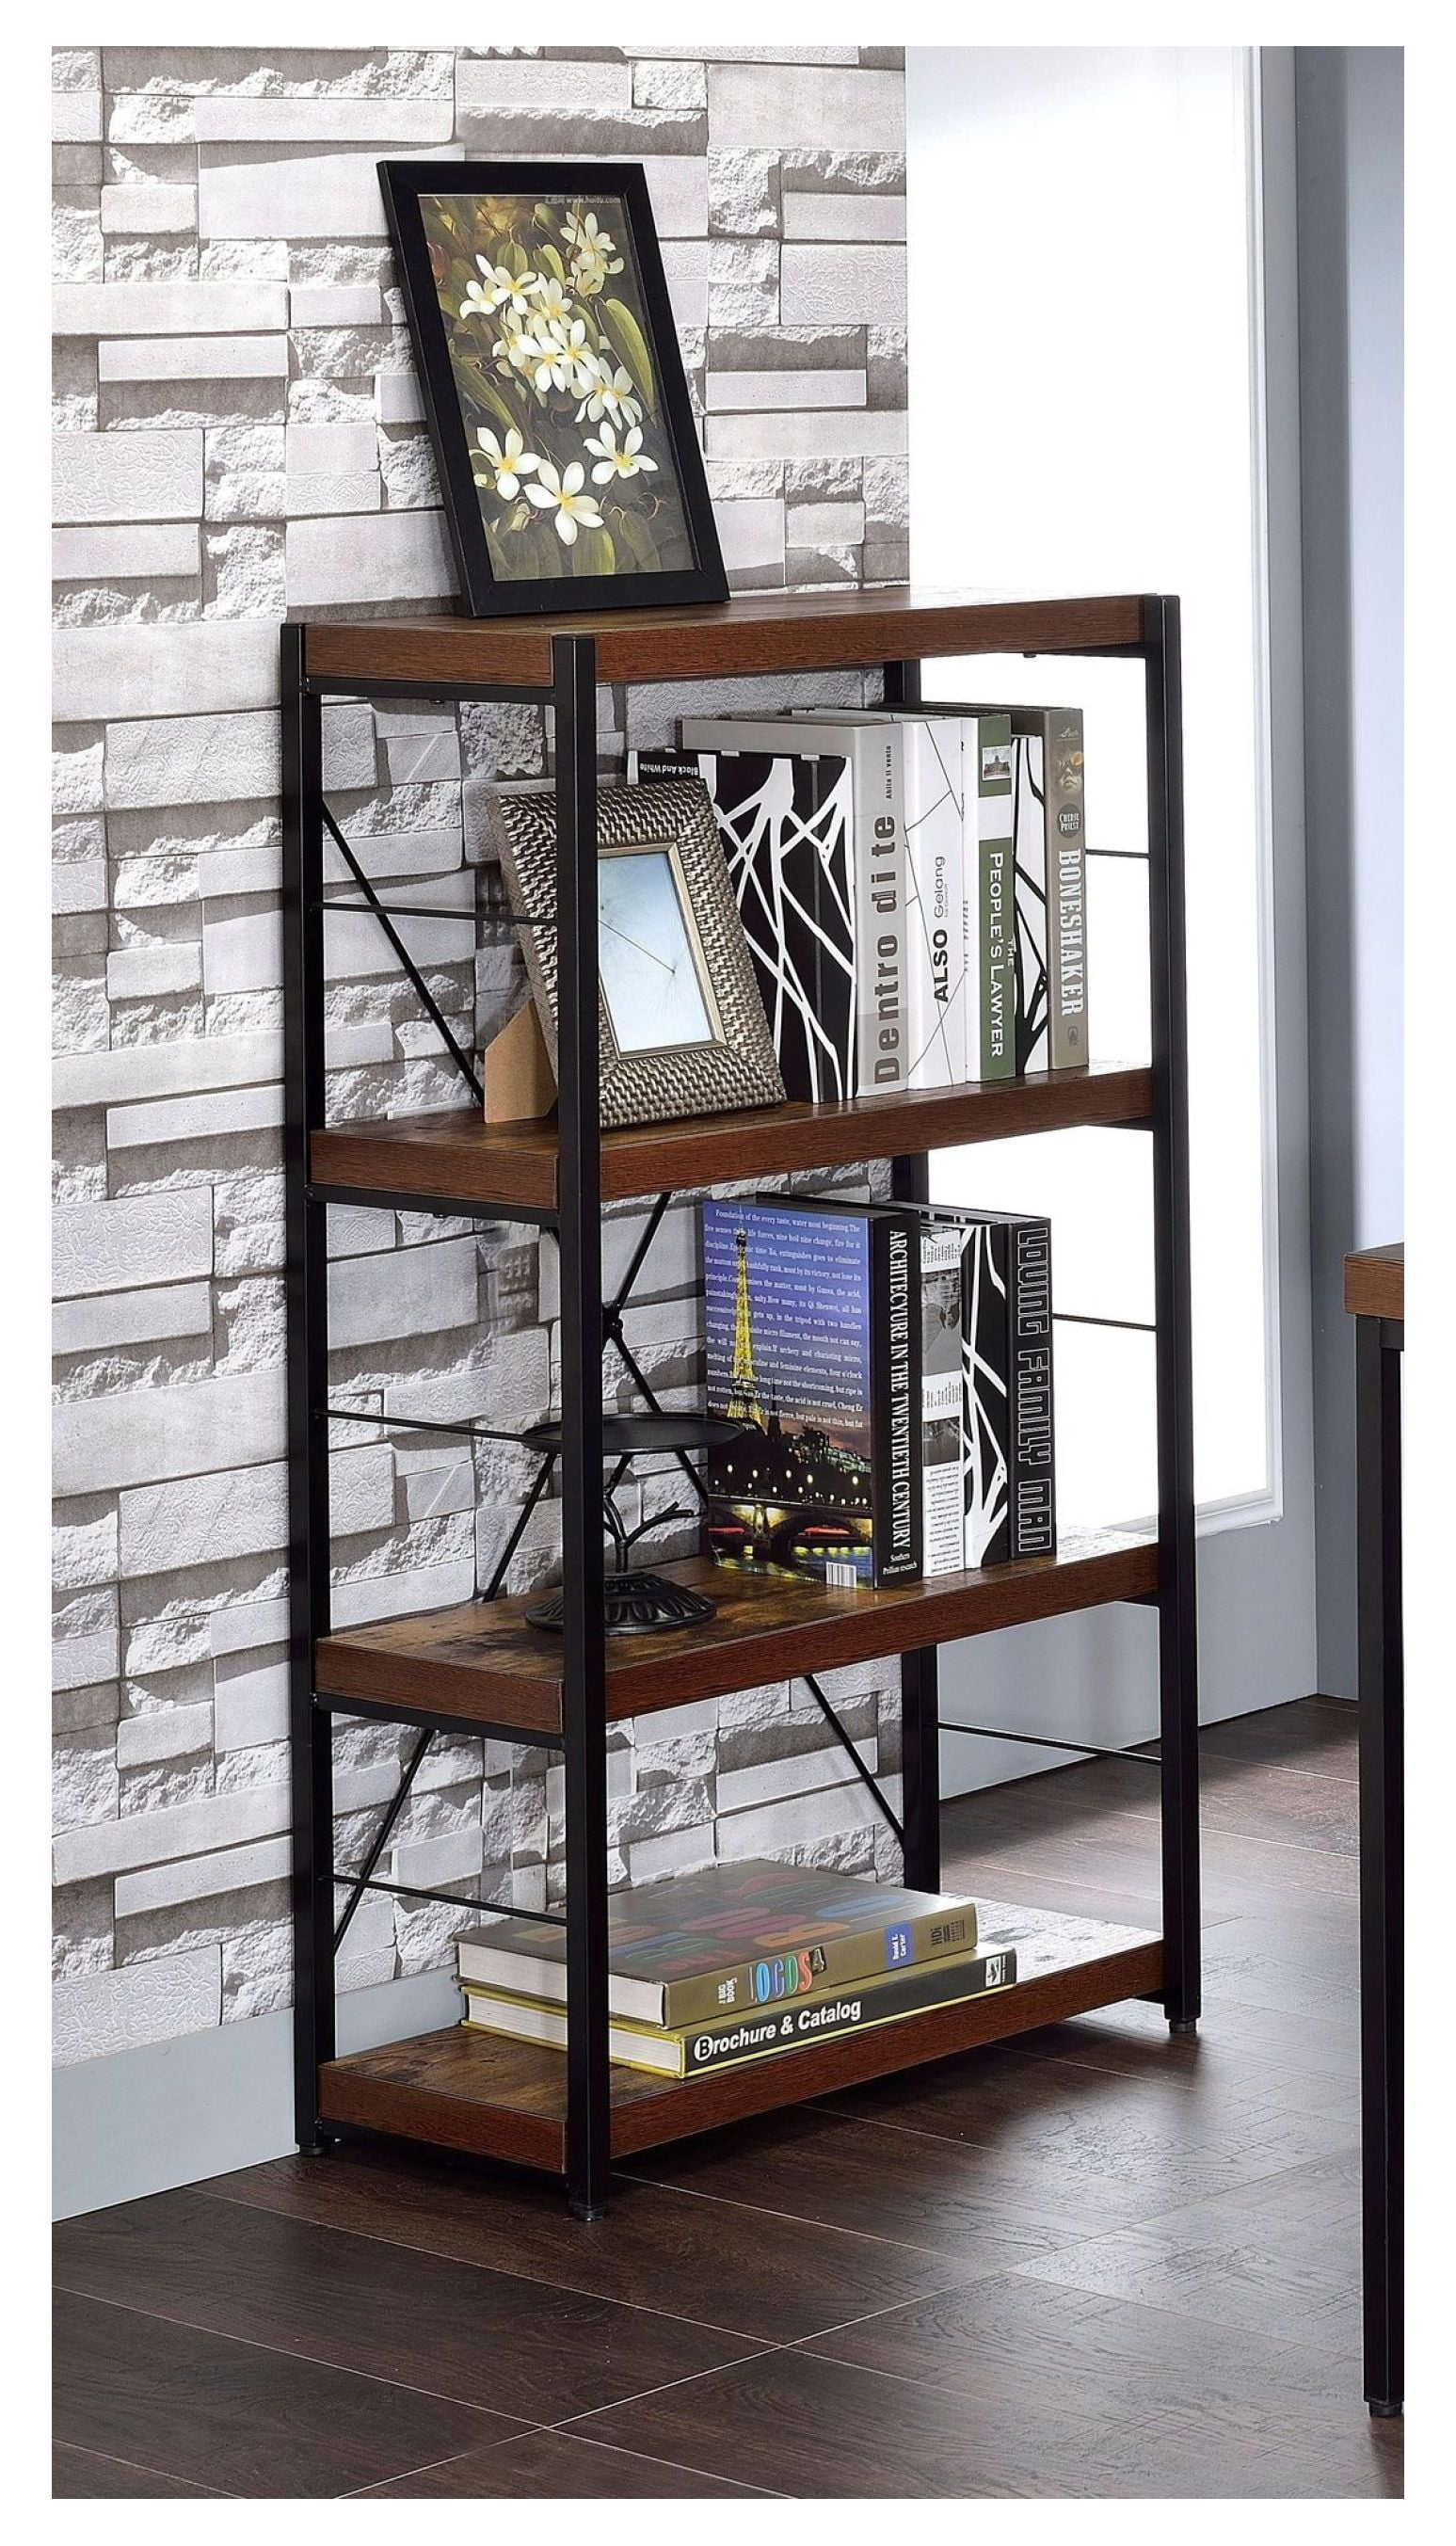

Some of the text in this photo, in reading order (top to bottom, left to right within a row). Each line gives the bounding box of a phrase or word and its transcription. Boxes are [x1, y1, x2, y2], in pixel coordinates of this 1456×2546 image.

[639, 762, 661, 773] White
[662, 764, 678, 775] And
[872, 816, 900, 1084] Dentro di te
[933, 929, 949, 1002] ALSO
[989, 852, 1004, 1057] PEOPLE'S LAWYER
[1059, 848, 1084, 1017] BONESHAKER
[889, 1230, 911, 1548] ARCHITECYURE IN THE TWENTIETH CENTURY
[1017, 1347, 1050, 1466] FAMILY
[1017, 1478, 1052, 1552] MAN
[694, 2000, 862, 2061] Brochure & Catalog
